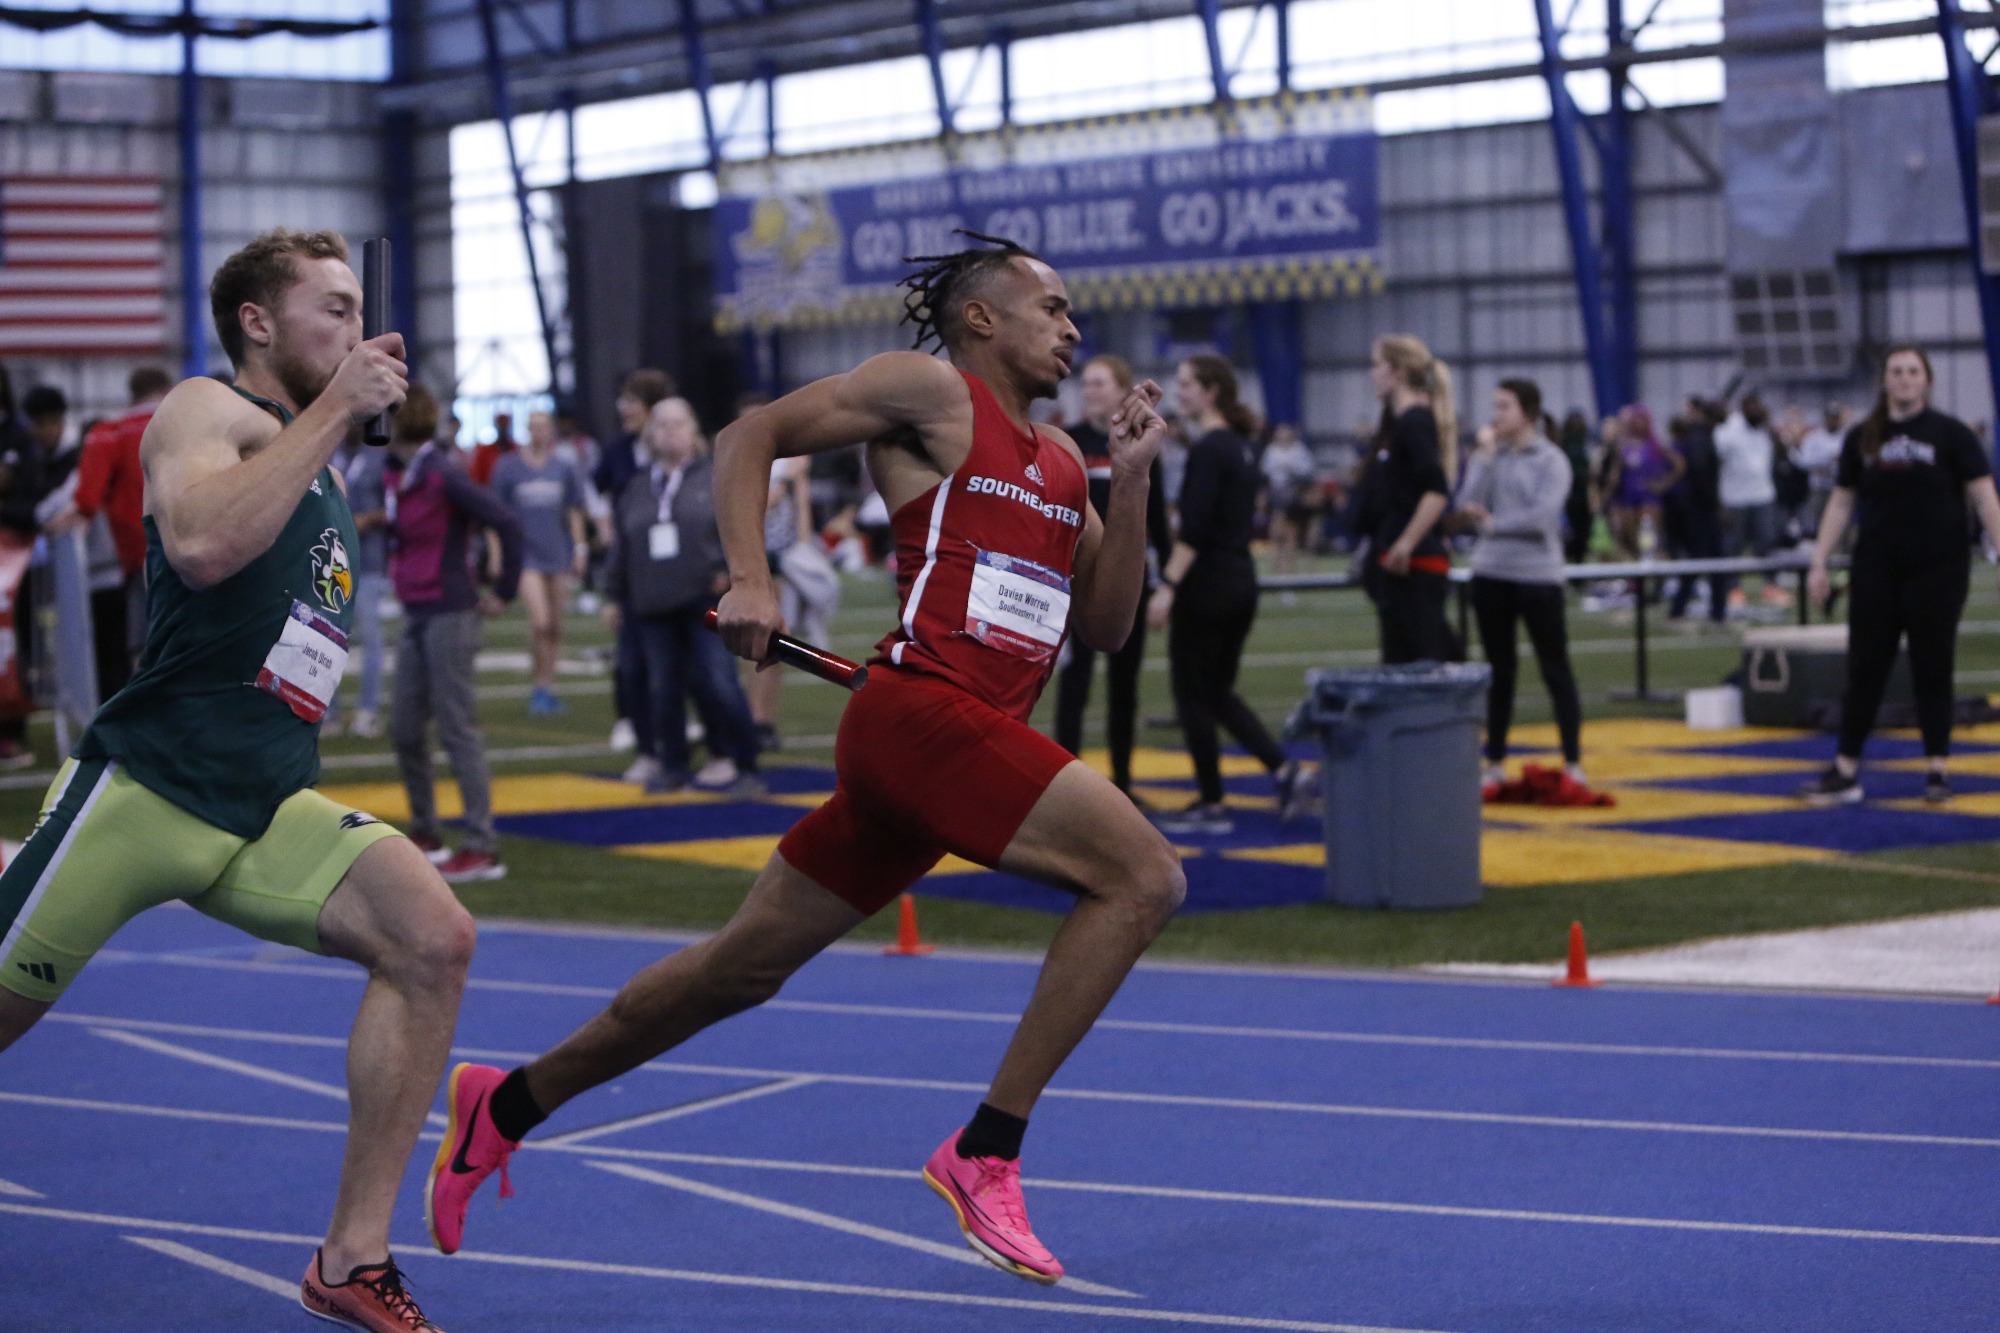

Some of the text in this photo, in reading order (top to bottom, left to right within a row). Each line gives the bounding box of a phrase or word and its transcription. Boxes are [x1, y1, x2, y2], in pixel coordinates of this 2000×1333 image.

[852, 219, 903, 271] GO
[985, 206, 1040, 254] GO
[1160, 190, 1220, 248] GO
[1222, 178, 1360, 251] JACKS.
[966, 475, 1081, 527] SOUTHESTER
[998, 600, 1036, 621] Southeastern
[302, 1280, 326, 1305] new
